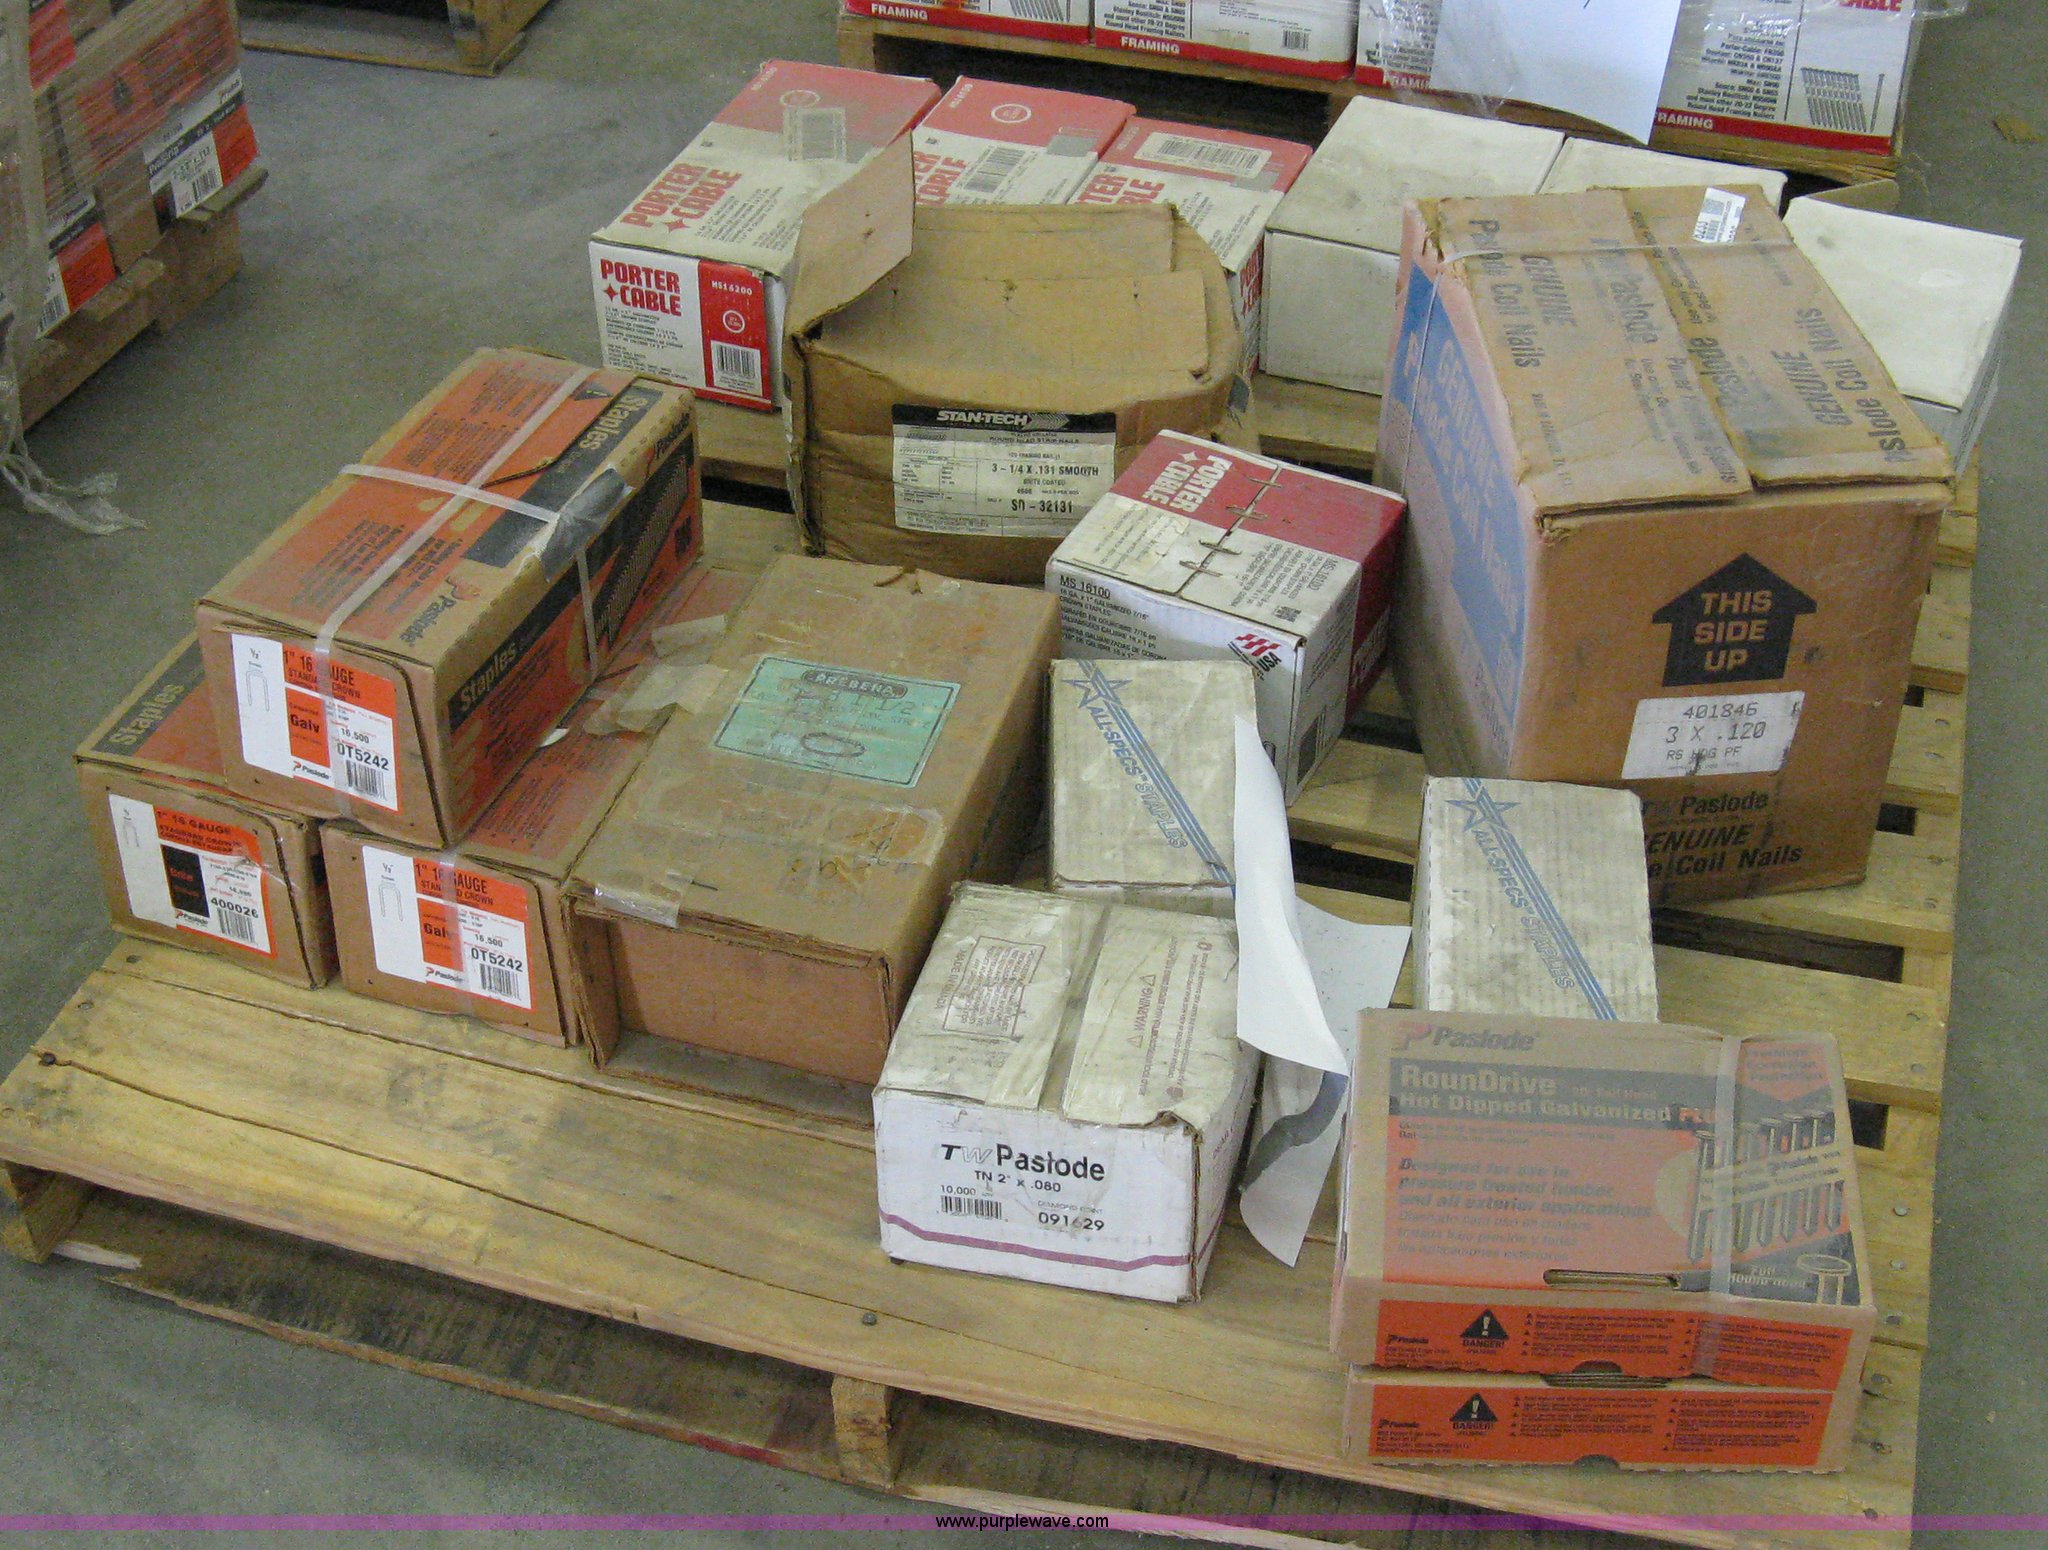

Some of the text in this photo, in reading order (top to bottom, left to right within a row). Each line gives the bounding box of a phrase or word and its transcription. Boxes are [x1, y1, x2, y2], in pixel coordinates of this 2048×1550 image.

[871, 3, 928, 21] FRAMING
[1121, 36, 1180, 54] FRAMING
[1725, 107, 1752, 118] Framing
[620, 163, 709, 229] PORTER
[671, 169, 743, 221] CABLE
[600, 259, 681, 294] PORTER
[619, 285, 682, 317] CABLE
[1503, 324, 1545, 367] Nails
[1794, 308, 1869, 391] Coil Nails
[1770, 350, 1853, 426] GENUINE
[578, 392, 649, 451] Staples
[936, 410, 1029, 428] STAN-TECH
[992, 463, 998, 472] 3
[1010, 464, 1023, 474] 1/4
[1026, 465, 1032, 474] X
[1035, 465, 1055, 475] .131
[1058, 466, 1099, 476] SMOOTH
[1141, 460, 1195, 505] CABLE
[1169, 455, 1233, 513] PORTER
[1039, 500, 1072, 513] 32131
[1060, 575, 1111, 600] MS 16100
[1700, 590, 1773, 616] THIS
[1694, 620, 1768, 645] SIDE
[300, 656, 313, 673] 16
[1257, 652, 1282, 672] USA
[1705, 650, 1748, 672] UP
[460, 639, 517, 712] Staples
[331, 682, 361, 699] CROWN
[108, 684, 186, 746] Staples
[1683, 702, 1758, 720] 401846
[291, 714, 320, 733] Galv
[1666, 721, 1767, 744] 3 X .120
[1666, 750, 1683, 760] RS
[1724, 746, 1742, 757] PF
[302, 765, 330, 780] Paslode
[1680, 791, 1769, 815] Paslode
[1135, 782, 1188, 849] STAPLES
[188, 820, 232, 836] GAUGE
[416, 864, 428, 877] 1"
[1675, 845, 1803, 876] Coil Nails
[465, 891, 493, 905] CROWN
[1520, 916, 1575, 989] STAPLES
[435, 971, 465, 983] Paslode
[1134, 987, 1152, 1031] WARNING
[1433, 1027, 1535, 1050] Paslode
[1401, 1065, 1557, 1095] RounDrive
[1448, 1095, 1532, 1119] Dipped
[1540, 1098, 1671, 1122] Galvanized
[1400, 1158, 1480, 1177] Designed
[1487, 1162, 1509, 1175] for
[941, 1185, 976, 1196] 10,000
[975, 1170, 992, 1181] TN
[1031, 1180, 1061, 1193] .080
[1481, 1178, 1547, 1194] treated
[1399, 1193, 1433, 1207] and
[1466, 1196, 1537, 1212] exterior
[1541, 1201, 1651, 1219] applications
[1039, 1211, 1105, 1231] 091629
